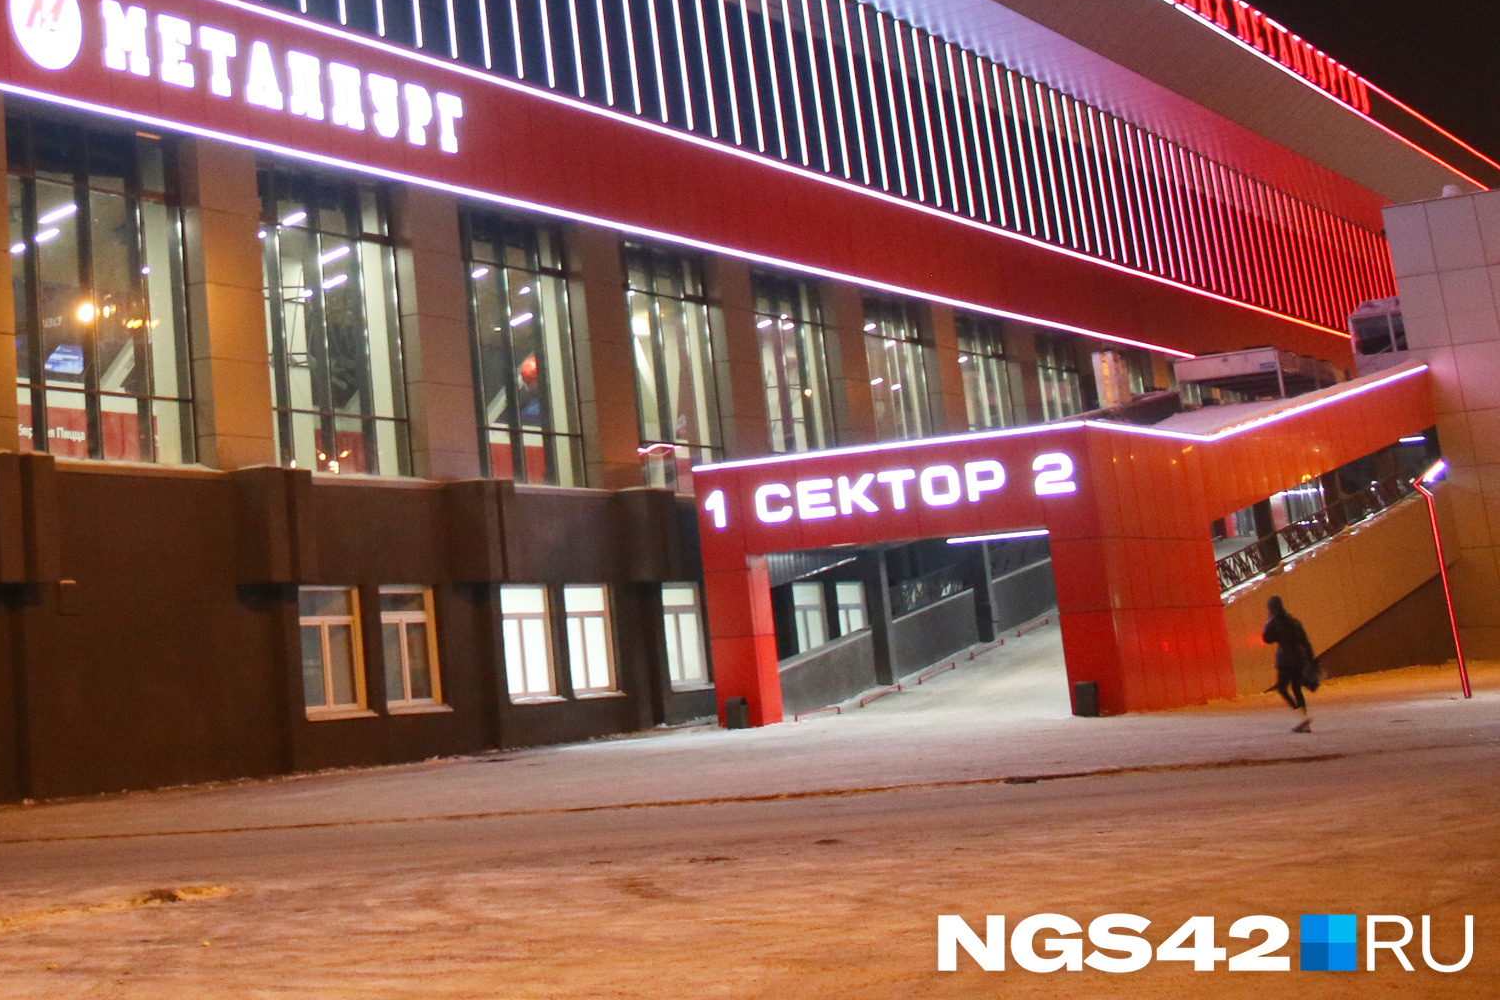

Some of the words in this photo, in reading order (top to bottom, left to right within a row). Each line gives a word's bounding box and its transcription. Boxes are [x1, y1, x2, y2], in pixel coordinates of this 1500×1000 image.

[704, 489, 728, 529] 1
[753, 459, 1008, 524] СЕКТОР
[1031, 452, 1078, 496] 2
